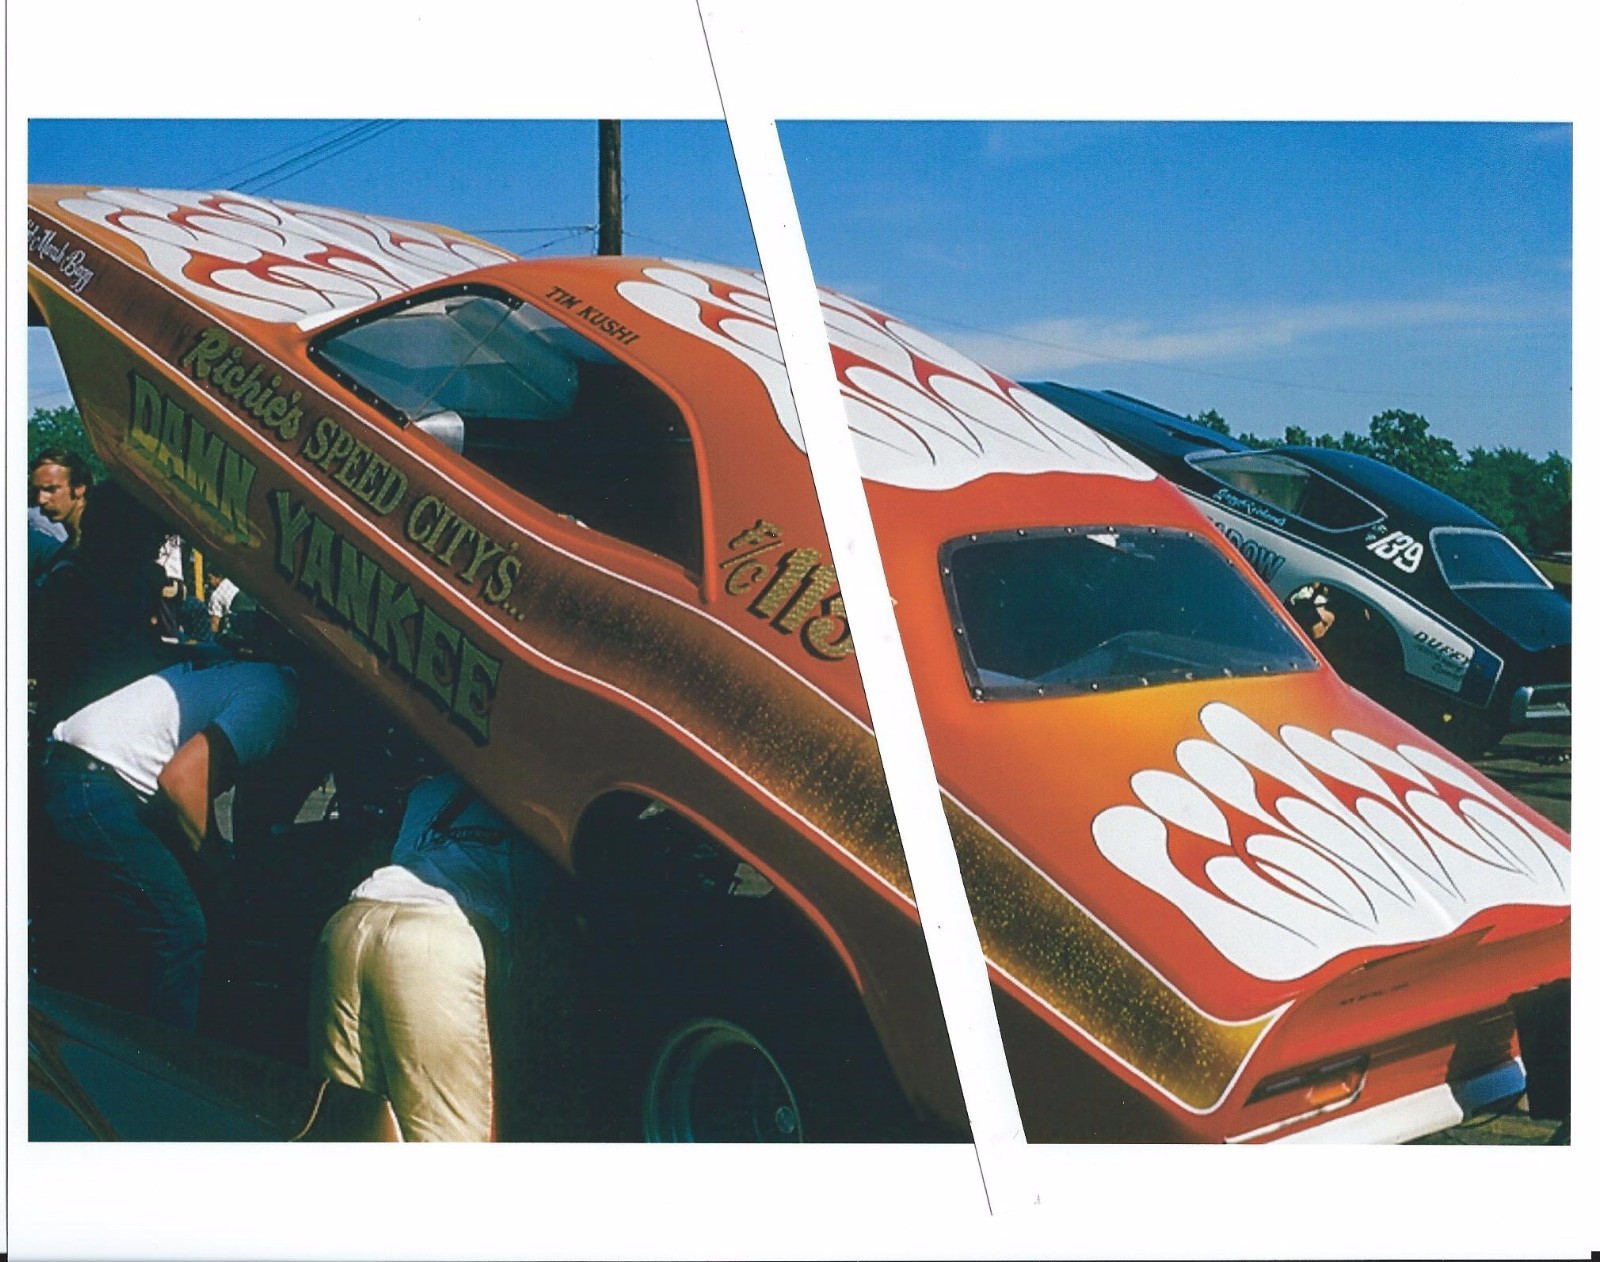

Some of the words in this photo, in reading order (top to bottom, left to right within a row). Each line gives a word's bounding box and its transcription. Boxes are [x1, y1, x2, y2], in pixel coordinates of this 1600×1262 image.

[546, 285, 582, 310] TIM
[577, 305, 640, 346] KUSHI
[181, 327, 304, 441] Richie's
[303, 417, 408, 516] SPEED
[129, 369, 257, 537] DAMN
[271, 489, 502, 745] YANKEE
[1365, 530, 1425, 574] 139
